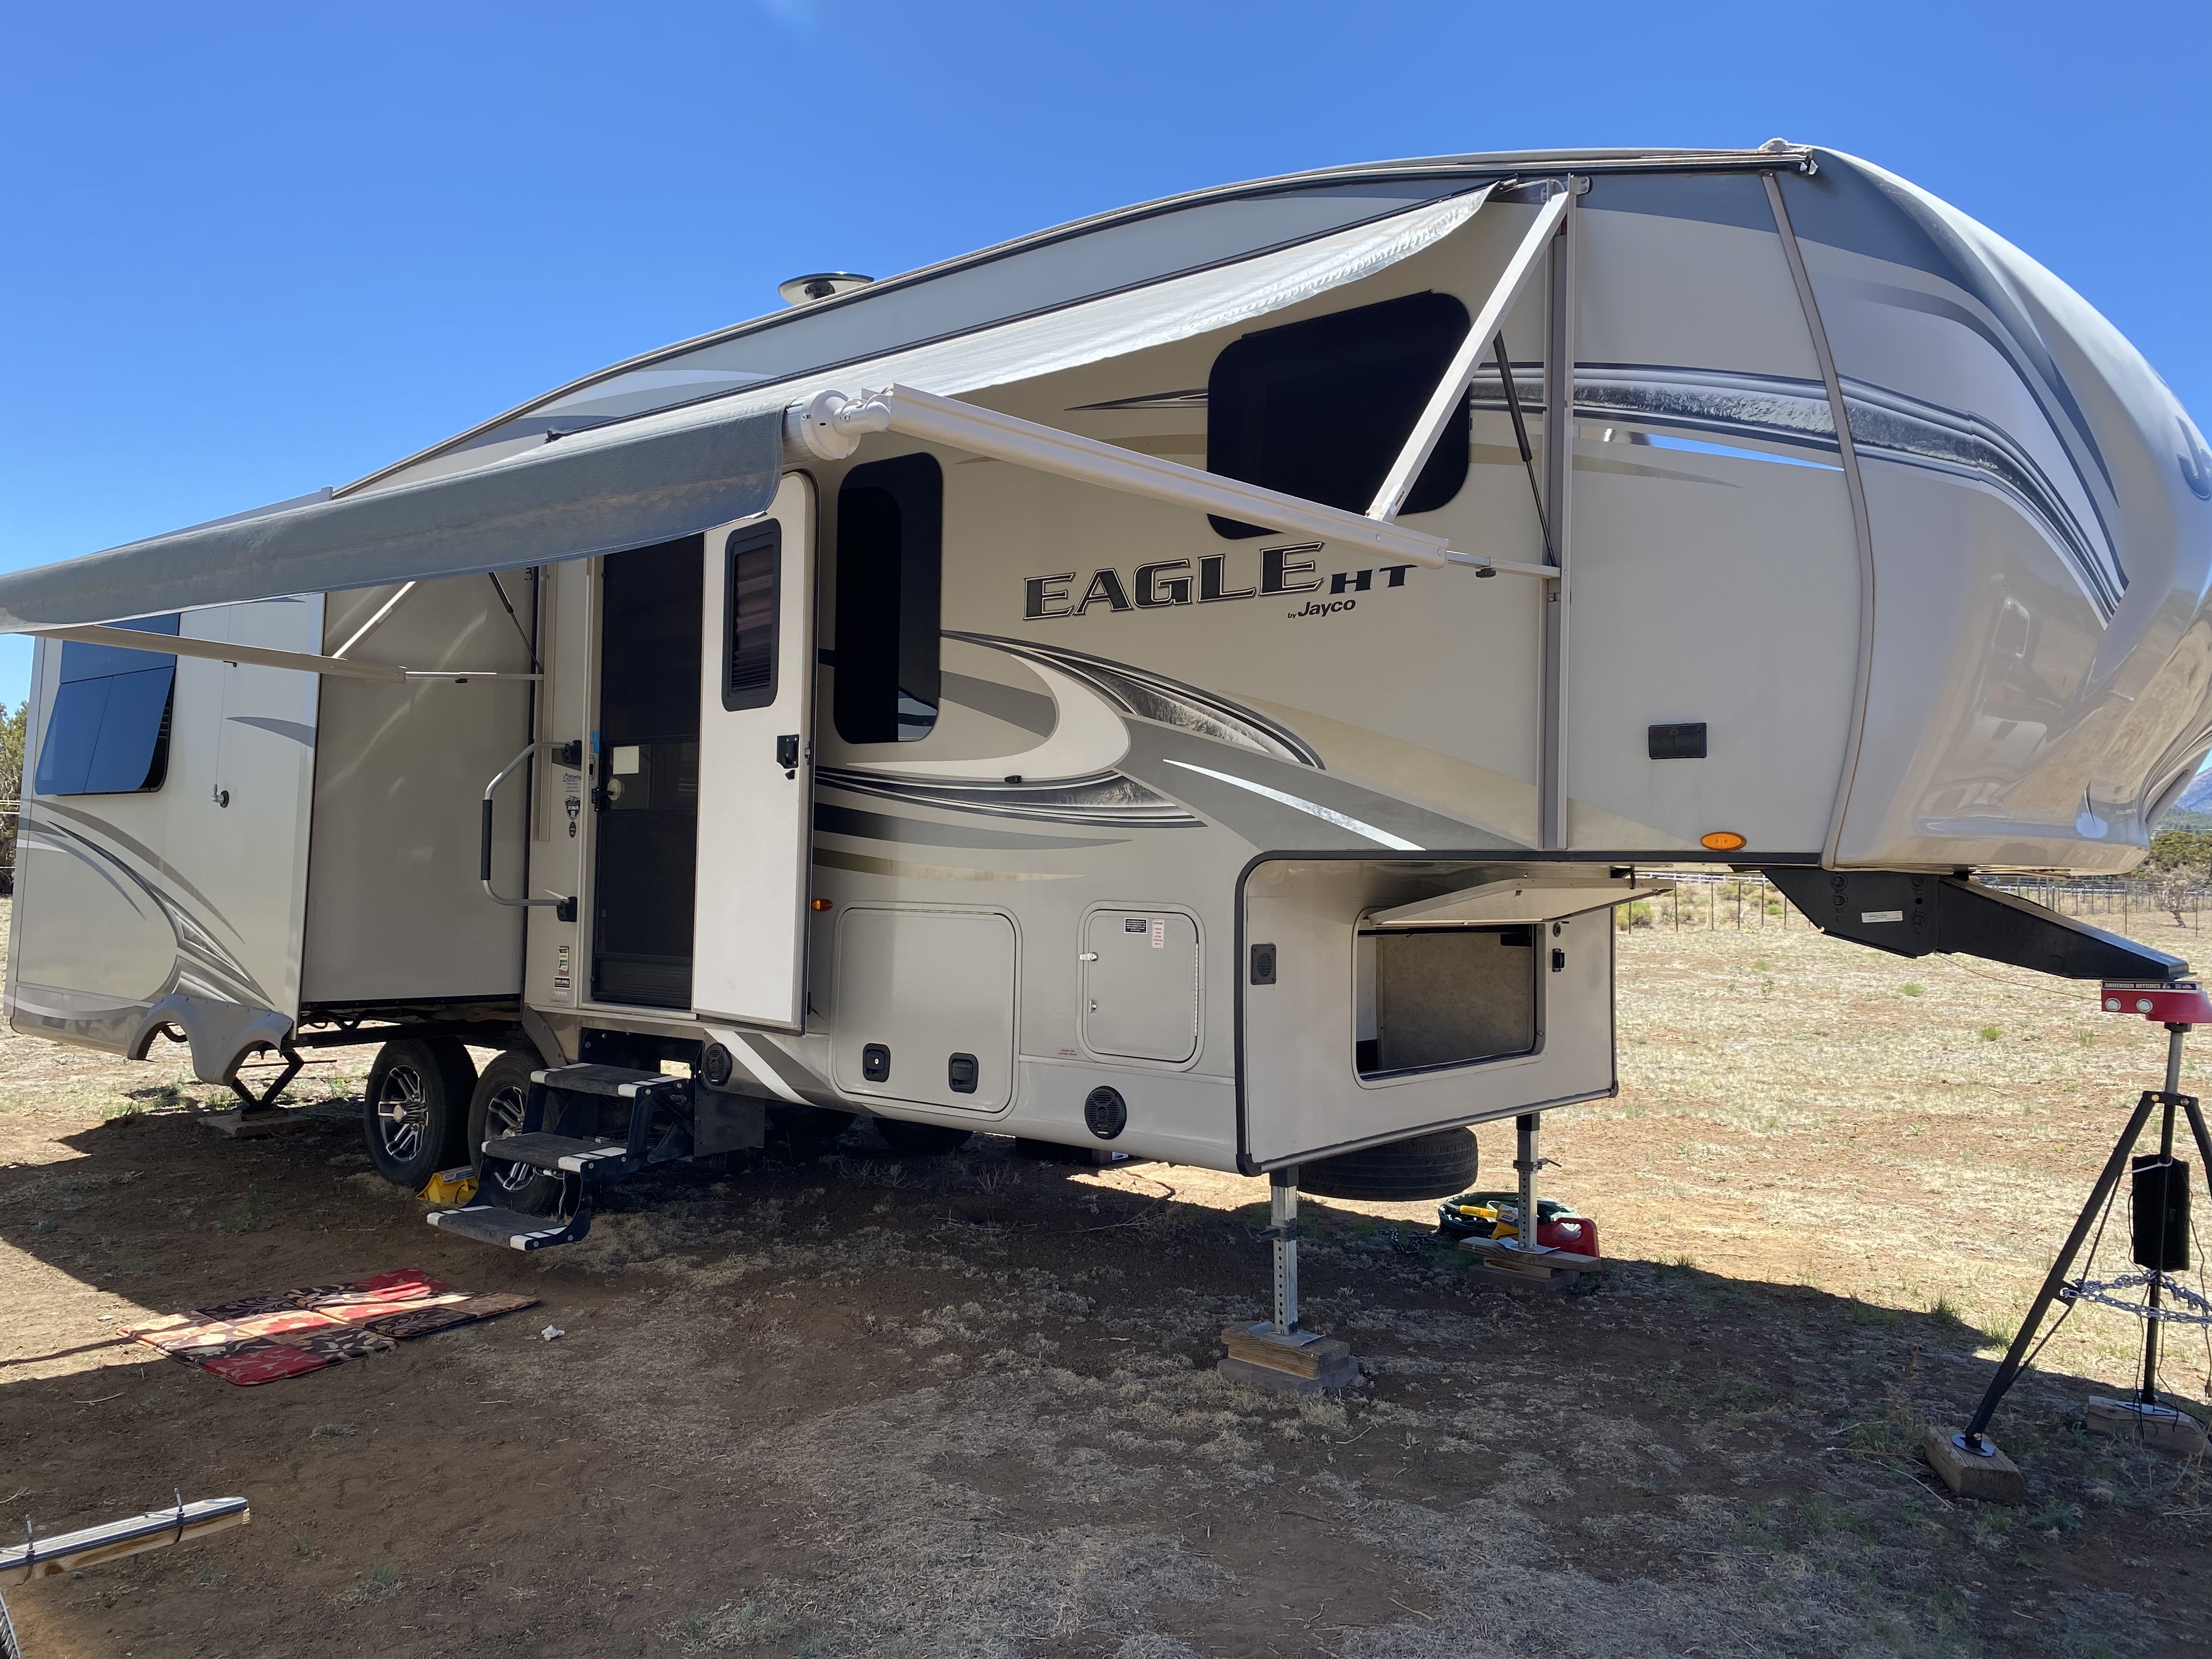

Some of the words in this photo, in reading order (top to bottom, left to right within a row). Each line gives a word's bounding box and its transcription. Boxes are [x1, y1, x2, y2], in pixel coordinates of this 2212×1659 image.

[1023, 541, 1325, 621] EAGLE
[1329, 564, 1418, 595] HT
[1297, 599, 1356, 617] Jayco
